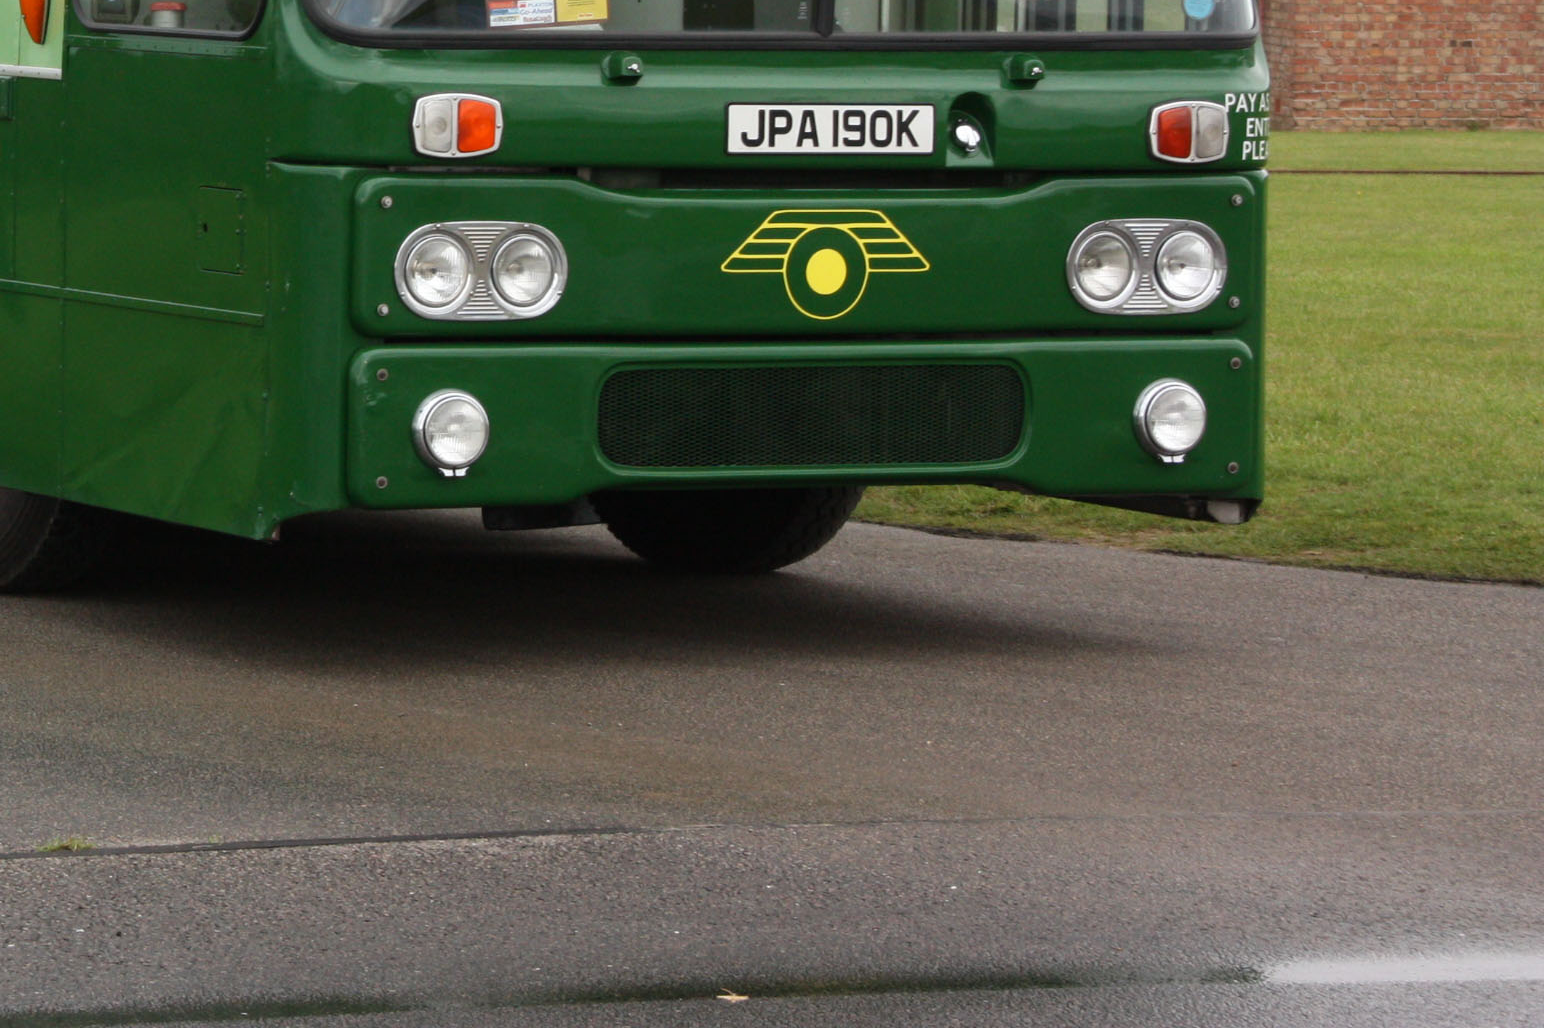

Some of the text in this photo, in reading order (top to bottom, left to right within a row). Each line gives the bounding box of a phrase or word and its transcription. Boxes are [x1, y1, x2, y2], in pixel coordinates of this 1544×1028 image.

[1224, 92, 1257, 113] PAY
[740, 109, 920, 147] JPA 190K
